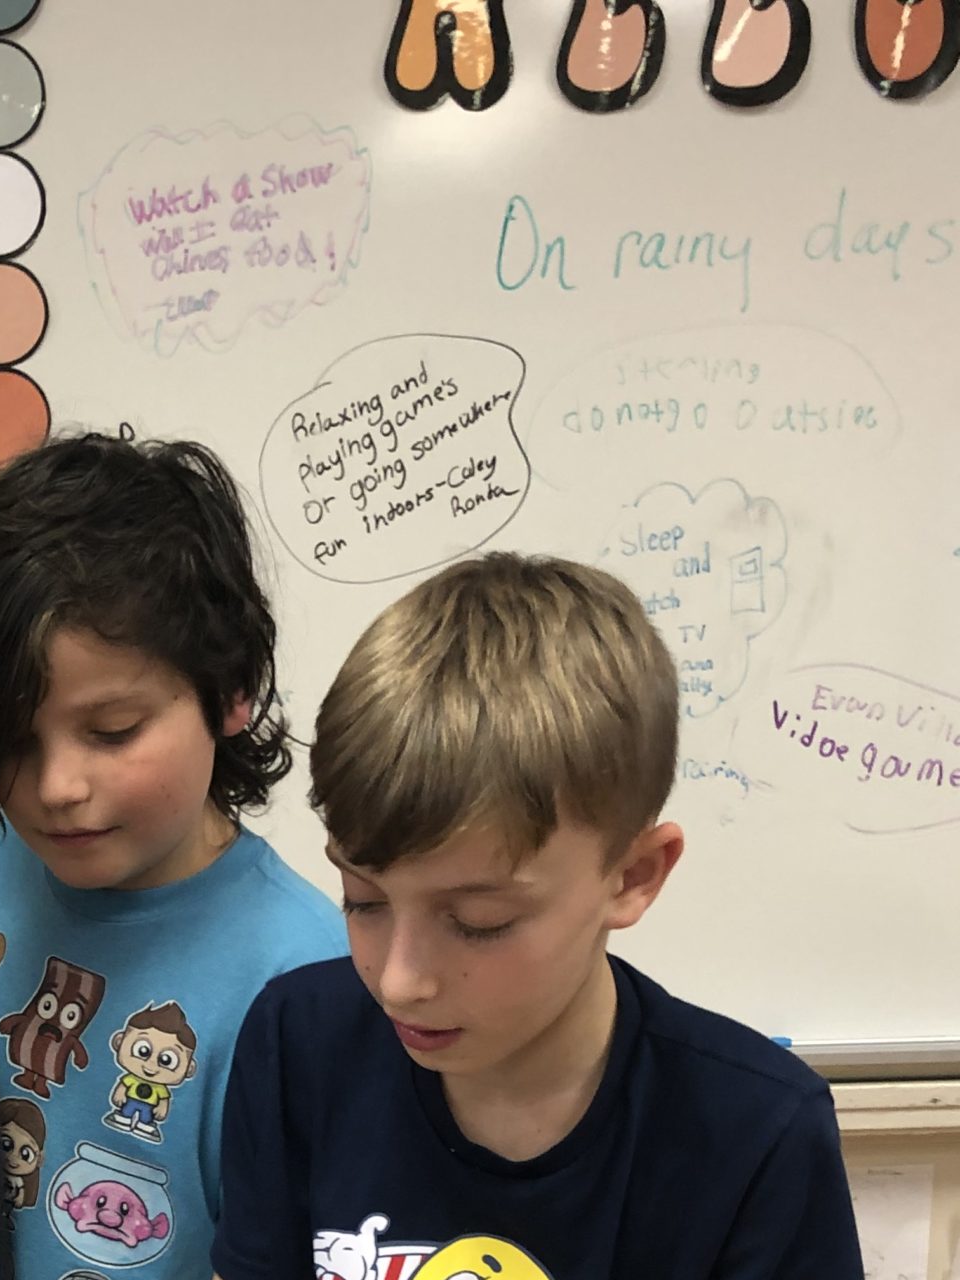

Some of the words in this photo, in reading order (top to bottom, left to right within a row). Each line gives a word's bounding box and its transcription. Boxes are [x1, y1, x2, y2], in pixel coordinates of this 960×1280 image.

[496, 195, 577, 291] On
[614, 230, 751, 313] rainy
[803, 187, 956, 282] days
[291, 394, 385, 442] Relaxing
[390, 360, 429, 400] and
[297, 432, 378, 493] playing
[349, 459, 406, 511] going
[677, 624, 706, 644] TV
